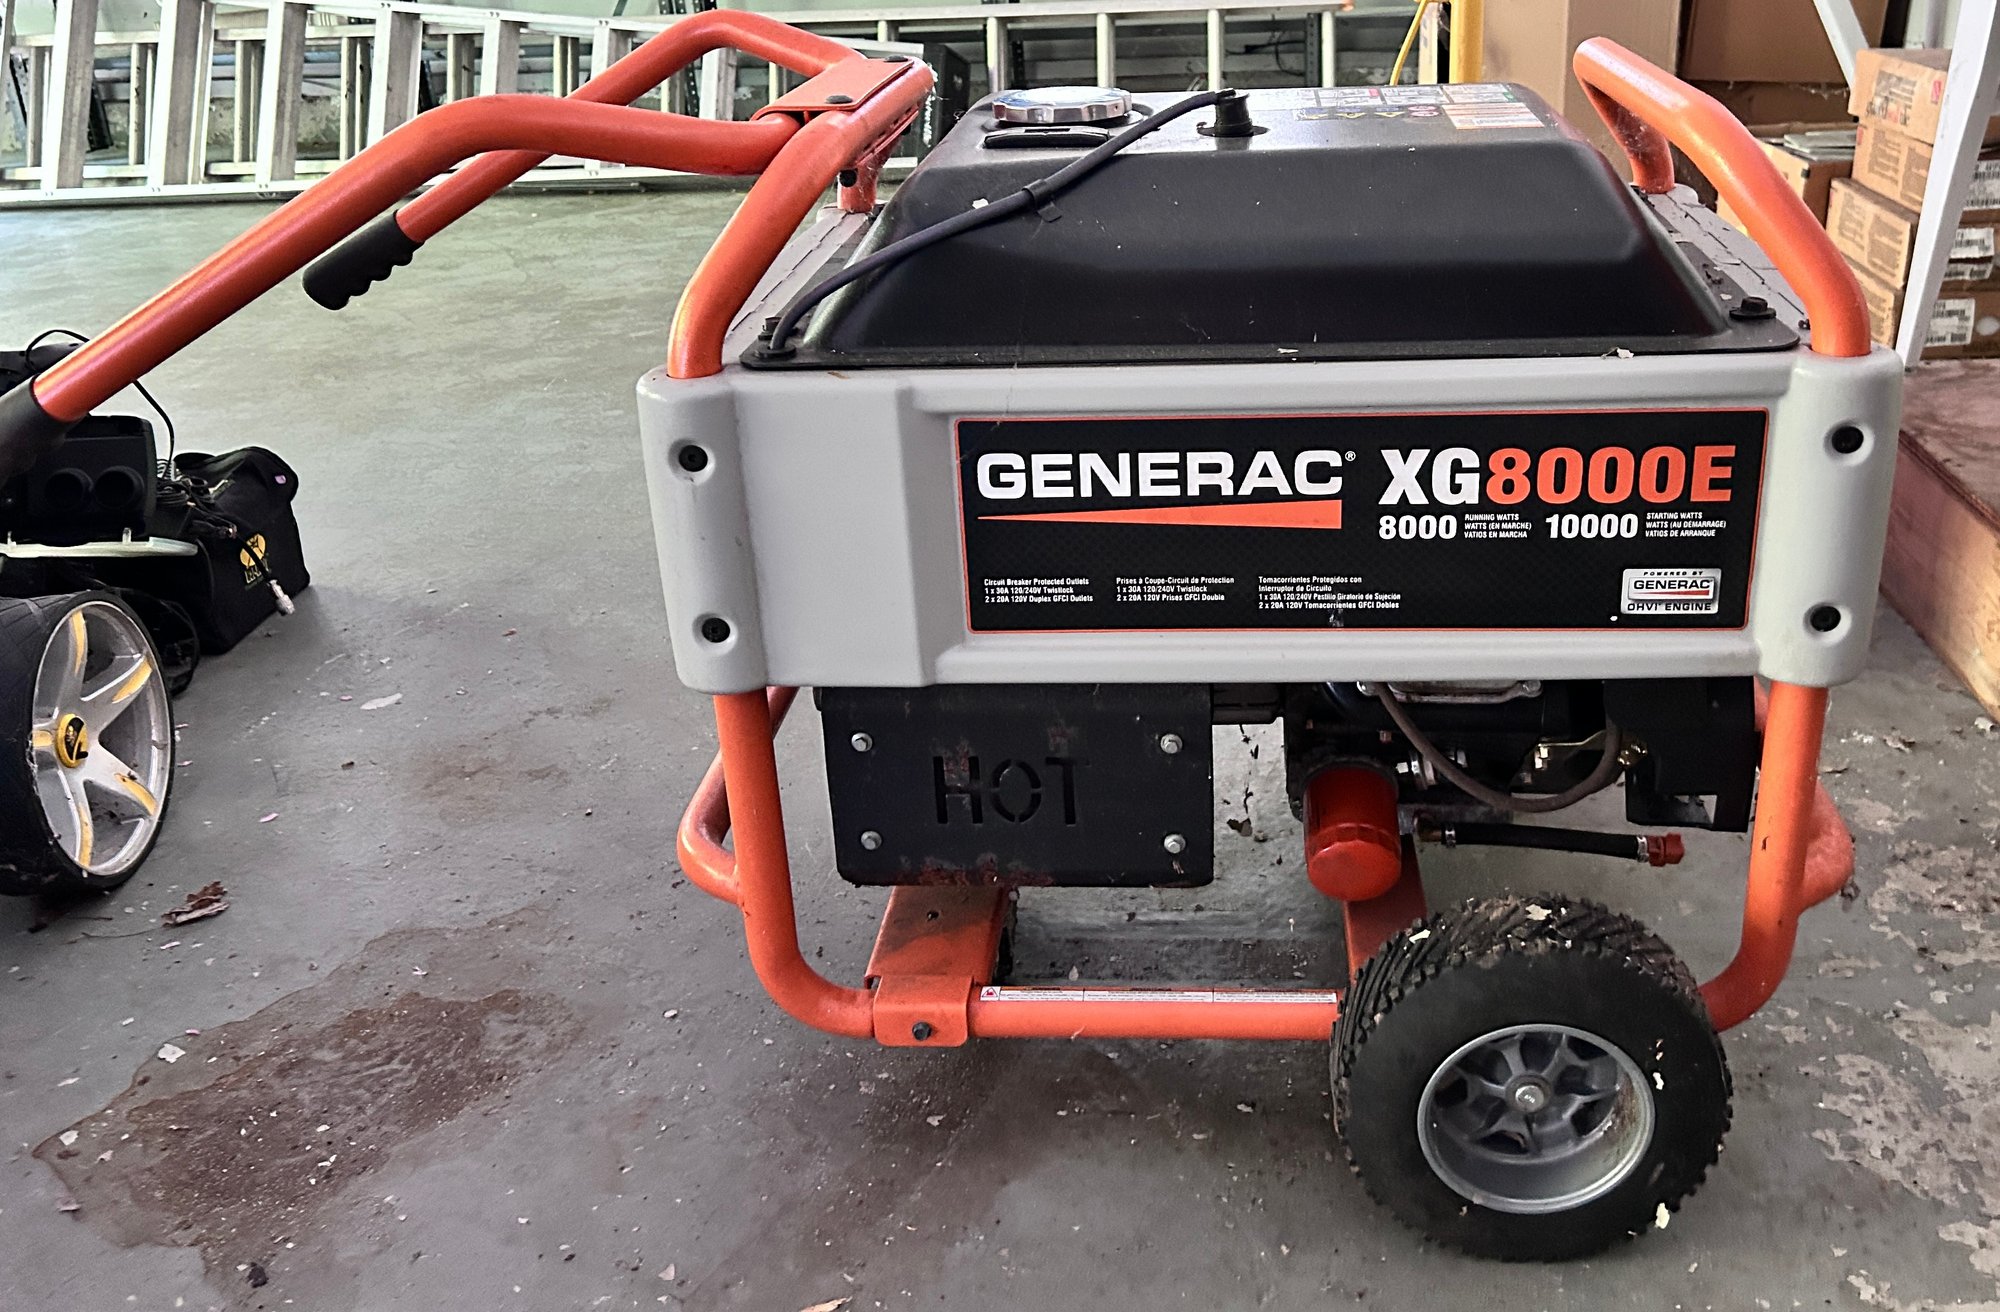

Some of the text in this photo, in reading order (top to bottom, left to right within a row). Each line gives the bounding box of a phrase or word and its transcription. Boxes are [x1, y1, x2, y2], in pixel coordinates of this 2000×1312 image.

[1378, 446, 1736, 505] XG8000E
[1680, 512, 1702, 520] WATTS
[1379, 515, 1457, 539] 8000
[1545, 513, 1638, 539] 10000
[1646, 520, 1668, 528] WATTS
[1670, 520, 1682, 530] (AU
[1464, 530, 1528, 538] VATIOS EN MARCHA
[1644, 528, 1716, 538] VATIOS DE ARRANQUE
[984, 578, 1006, 586] Circuit
[1006, 578, 1032, 586] Breaker
[1032, 578, 1064, 586] Protected
[1116, 576, 1138, 584] Prises
[1312, 576, 1348, 584] Protegidos
[996, 586, 1008, 594] 30A
[1010, 586, 1042, 594] 120/240V
[1042, 586, 1074, 594] Twistlock
[1028, 596, 1052, 604] Duplex
[1052, 594, 1068, 602] GFCI
[1364, 592, 1374, 600] de
[1664, 602, 1712, 610] ENGINE
[933, 756, 1091, 824] HOT
